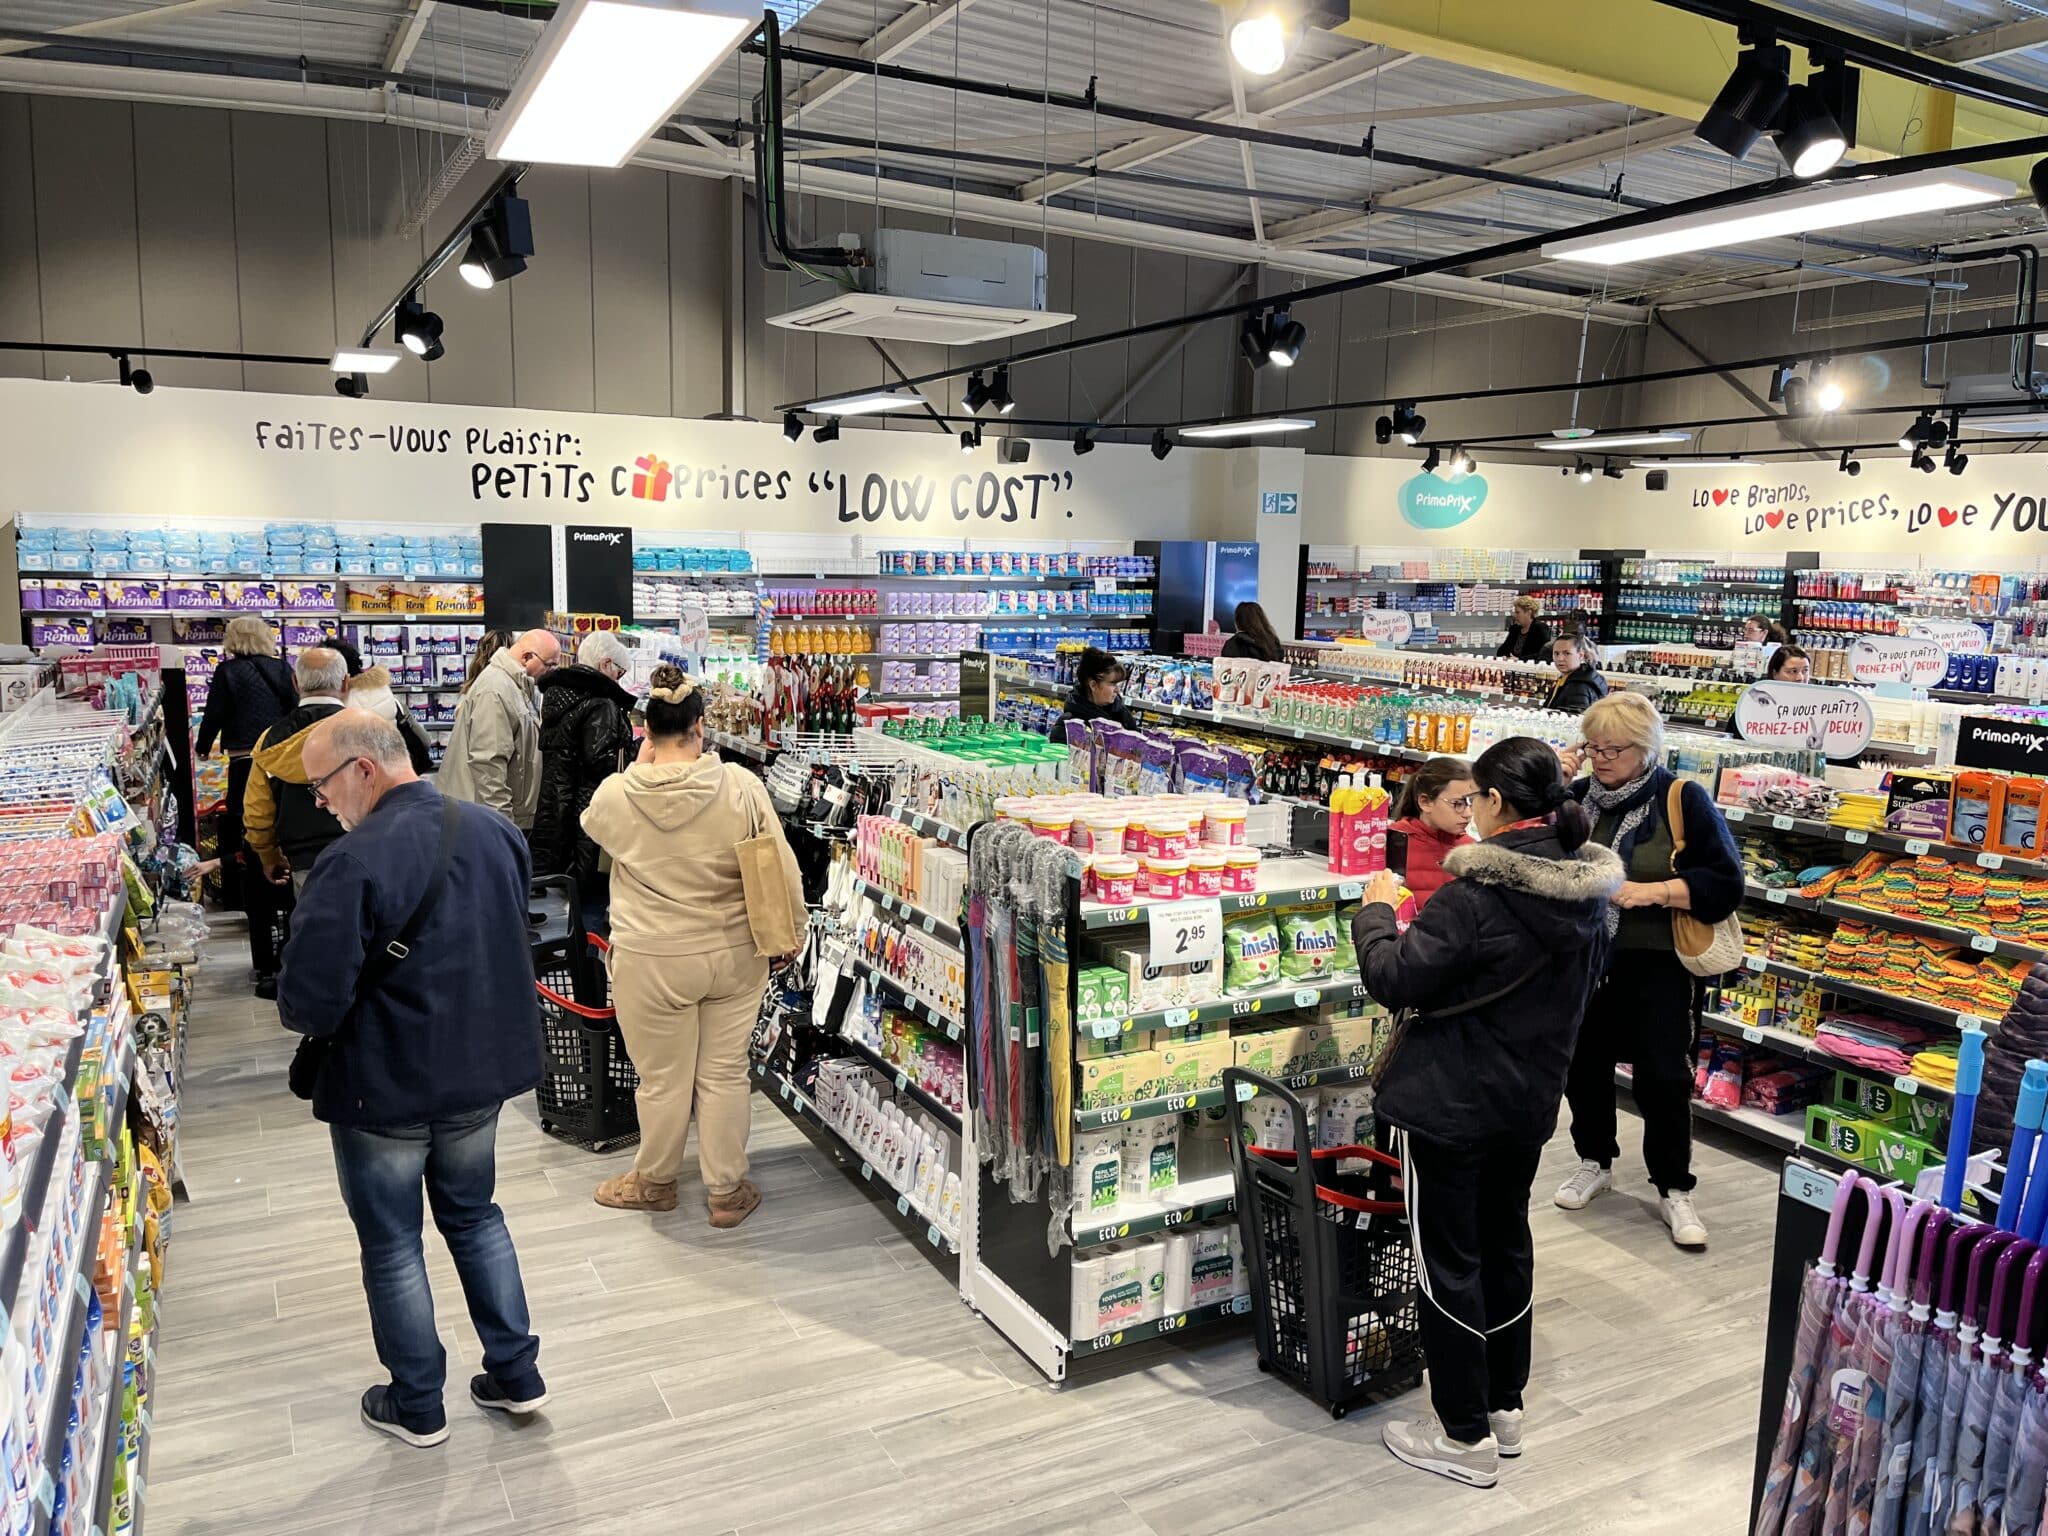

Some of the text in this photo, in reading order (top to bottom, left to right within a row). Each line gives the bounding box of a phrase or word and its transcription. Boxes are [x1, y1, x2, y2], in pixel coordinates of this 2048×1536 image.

[56, 592, 101, 607] Renova
[118, 592, 162, 607] Renova
[179, 592, 222, 607] Renova
[237, 592, 279, 607] Renova
[294, 592, 334, 607] Renova
[362, 600, 391, 610] Renov
[44, 629, 90, 642] Renova
[1879, 647, 1938, 662] ÇA VOUS PLAÎT?
[1856, 661, 1940, 673] PRENEZ-EN DEUX!
[1778, 700, 1859, 719] ÇA VOUS PLAÎT?
[1746, 720, 1863, 738] PRENEZ-EN DEUX!
[1892, 800, 1928, 811] suaves
[1239, 895, 1256, 907] ECO
[1300, 887, 1317, 901] ECO
[1107, 909, 1126, 921] ECO
[1296, 930, 1336, 950] finish
[1233, 1002, 1250, 1014] ECO
[1350, 1066, 1365, 1078] ECO
[1291, 1076, 1307, 1088] ECO
[1168, 1098, 1184, 1111] ECO
[1875, 1089, 1886, 1111] KIT
[1101, 1110, 1119, 1124] ECO
[1844, 1129, 1855, 1152] KIT
[1165, 1212, 1182, 1226] ECO
[1100, 1227, 1117, 1241] ECO
[1102, 1292, 1117, 1302] 100%
[1220, 1303, 1232, 1315] EC
[1158, 1319, 1176, 1332] ECO
[1093, 1336, 1111, 1350] ECO
